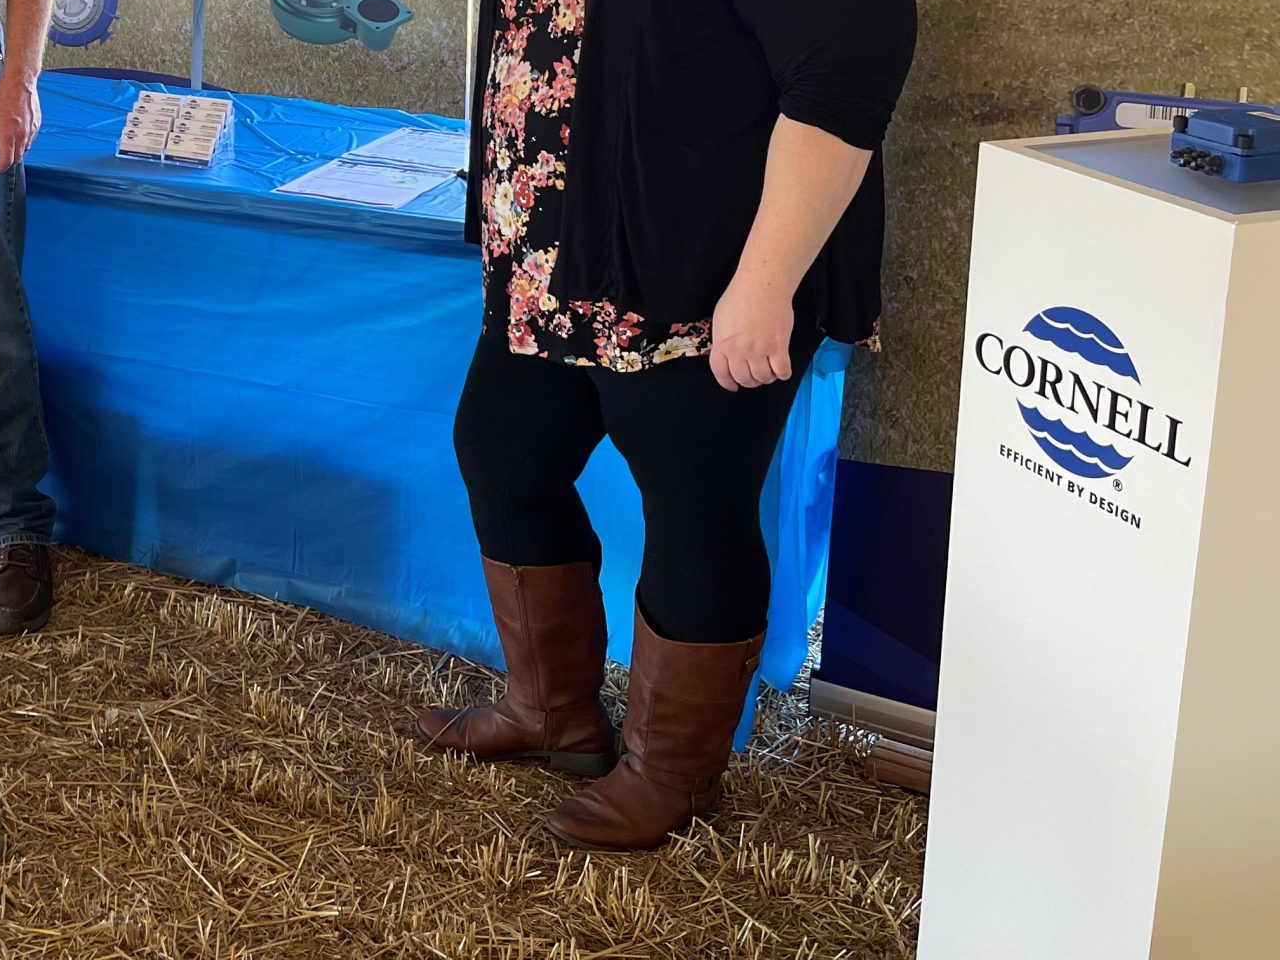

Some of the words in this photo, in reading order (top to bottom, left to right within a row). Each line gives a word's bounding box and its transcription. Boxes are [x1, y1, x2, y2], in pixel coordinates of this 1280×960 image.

[975, 332, 1192, 468] CORNELL
[999, 444, 1063, 486] EFFICIENT
[1067, 480, 1085, 498] BY
[1089, 491, 1141, 529] DESIGN
